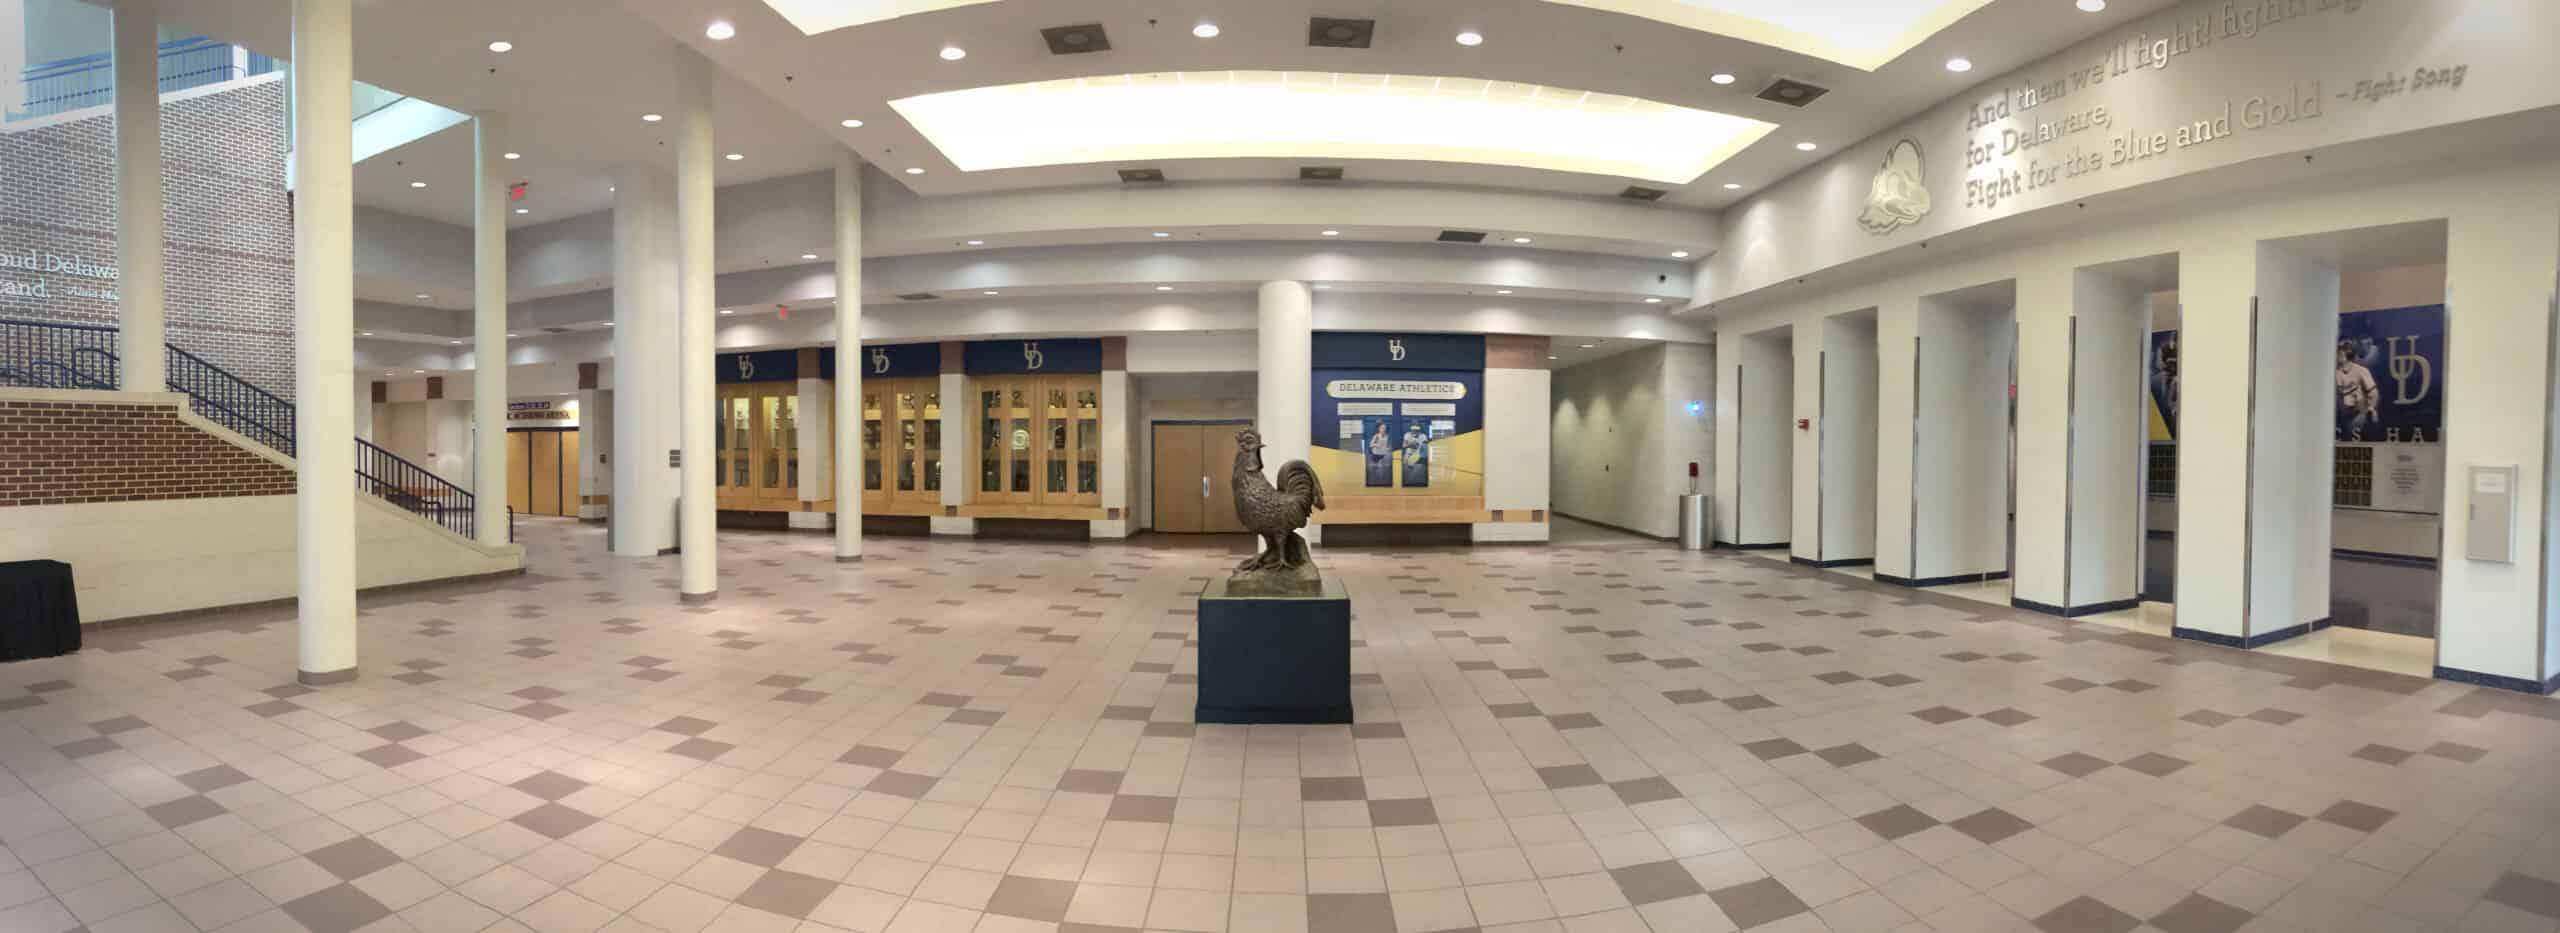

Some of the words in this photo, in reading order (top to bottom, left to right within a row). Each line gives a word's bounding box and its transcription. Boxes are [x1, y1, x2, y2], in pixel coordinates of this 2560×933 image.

[1966, 87, 2010, 131] And
[2016, 79, 2067, 112] then
[2069, 38, 2129, 90] we'll
[2133, 14, 2213, 70] fight!
[2411, 64, 2468, 92] Song
[1966, 139, 1996, 169] for
[2001, 104, 2113, 156] Delaware,
[1966, 168, 2022, 208] Fight
[2027, 160, 2061, 190] for
[2063, 145, 2103, 178] the
[2110, 128, 2168, 167] Blue
[2175, 100, 2233, 149] and
[2240, 80, 2323, 129] Gold
[1338, 383, 1396, 392] DELAWARE
